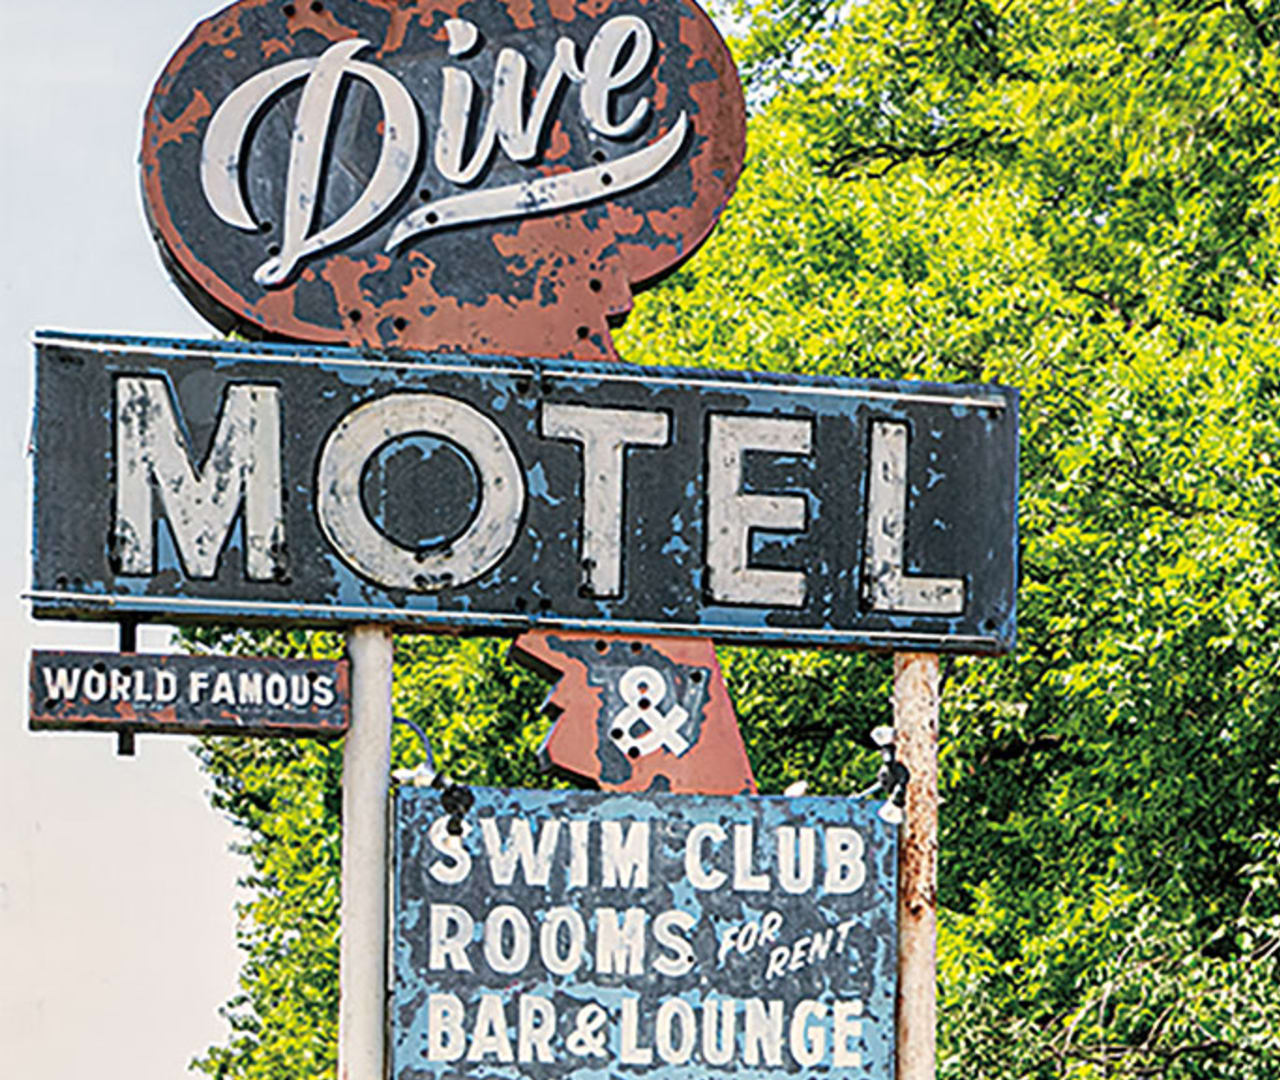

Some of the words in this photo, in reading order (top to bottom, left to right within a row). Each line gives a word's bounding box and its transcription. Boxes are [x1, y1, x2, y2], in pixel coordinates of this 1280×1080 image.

[201, 14, 688, 287] Dive
[112, 373, 966, 614] MOTEL
[42, 666, 178, 702] WORLD
[188, 671, 336, 707] FAMOUS
[614, 665, 691, 760] &
[427, 814, 651, 890] SWIM
[684, 821, 868, 895] CLUB
[428, 902, 697, 978] ROOMS
[715, 910, 784, 965] FOR
[763, 920, 858, 981] RENT
